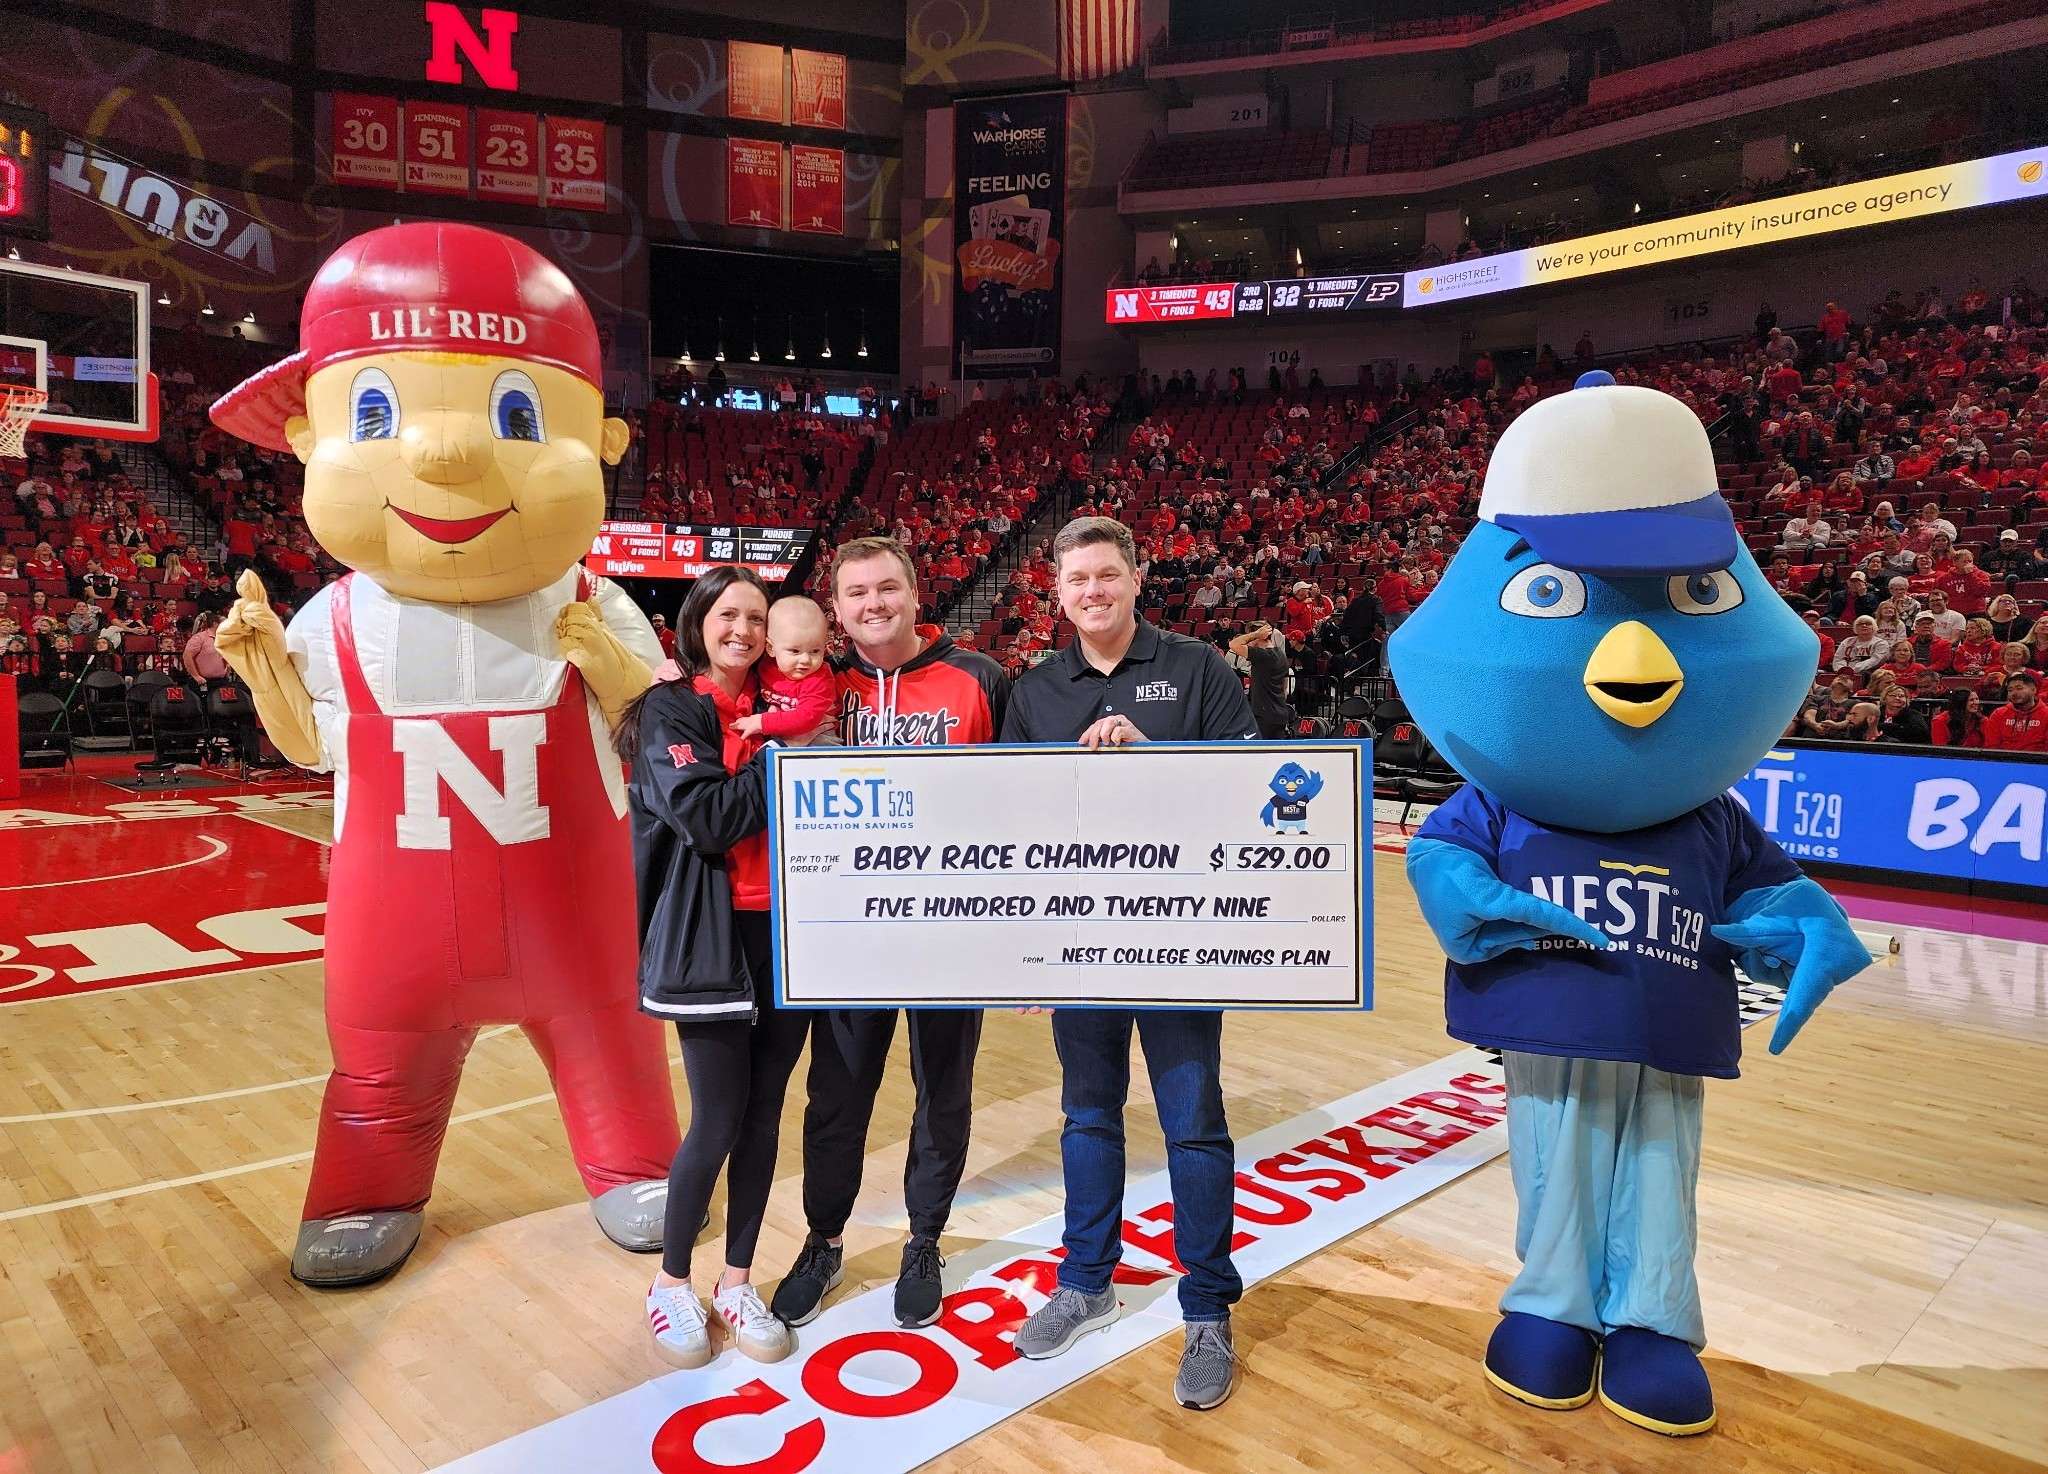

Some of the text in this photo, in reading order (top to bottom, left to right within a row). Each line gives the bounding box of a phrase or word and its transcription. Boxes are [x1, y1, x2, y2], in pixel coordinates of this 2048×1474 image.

[426, 1, 518, 91] N
[356, 108, 374, 117] IVY
[1231, 108, 1261, 121] 201
[414, 114, 461, 128] JENNINGS
[343, 119, 388, 152] 30
[489, 123, 525, 136] GRIFFIN
[557, 128, 594, 141] HOOPER
[973, 128, 1046, 145] WARHORSE
[417, 127, 456, 160] 51
[1005, 139, 1046, 152] CASINO
[486, 136, 529, 167] 23
[554, 143, 597, 175] 35
[336, 160, 352, 174] N
[408, 166, 424, 180] N
[735, 165, 754, 174] 2010
[480, 174, 495, 188] N
[820, 174, 839, 183] 2010
[968, 172, 1051, 194] FEELING
[551, 181, 565, 195] N
[750, 210, 760, 221] N
[812, 216, 822, 228] N
[1537, 183, 1952, 271] We're your community insurance agency
[969, 245, 1047, 287] Lucky?
[1436, 265, 1498, 285] HIGHSTREET
[1243, 286, 1260, 297] 3RD
[1307, 280, 1357, 292] 4 TIMEOUTS
[1366, 282, 1399, 302] P
[1150, 289, 1198, 300] 3 TIMEOUTS
[1204, 289, 1231, 310] 43
[1273, 286, 1300, 307] 32
[1115, 293, 1138, 318] N
[1161, 305, 1195, 316] 0 FOULS
[1308, 297, 1344, 309] 0 FOULS
[448, 309, 527, 345] RED
[1269, 350, 1300, 368] 104
[609, 522, 652, 533] NEBRASKA
[762, 529, 794, 539] PURDUE
[629, 538, 662, 547] TIMEOUTS
[672, 539, 697, 557] 43
[709, 540, 734, 559] 32
[744, 543, 782, 552] 4 TIMEOUTS
[631, 548, 660, 557] 0 FOULS
[745, 552, 773, 561] 0 FOULS
[167, 687, 184, 700] N
[220, 687, 237, 700] N
[1135, 683, 1168, 699] NEST
[1299, 719, 1315, 734] N
[1343, 720, 1360, 737] N
[1393, 725, 1412, 741] N
[667, 744, 698, 768] N
[393, 712, 550, 850] N
[794, 778, 914, 818] NEST 529
[1793, 791, 1842, 839] 529
[1906, 776, 2048, 861] BA
[795, 822, 914, 831] EDUCATION SAVINGS
[790, 855, 840, 864] PAY TO THE
[853, 843, 1180, 871] BABY RACE CHAMPION
[1236, 846, 1331, 870] 529.00
[790, 865, 832, 874] ORDER OF
[864, 895, 1271, 918] FIVE HUNDRED AND TWENTY NINE
[1311, 915, 1346, 923] DOLLARS
[1671, 905, 1705, 953] 529
[1022, 957, 1044, 965] FROM
[1062, 947, 1331, 966] NEST COLLEGE SAVINGS PLAN
[1534, 939, 1699, 971] EDUCAON SAVINGS
